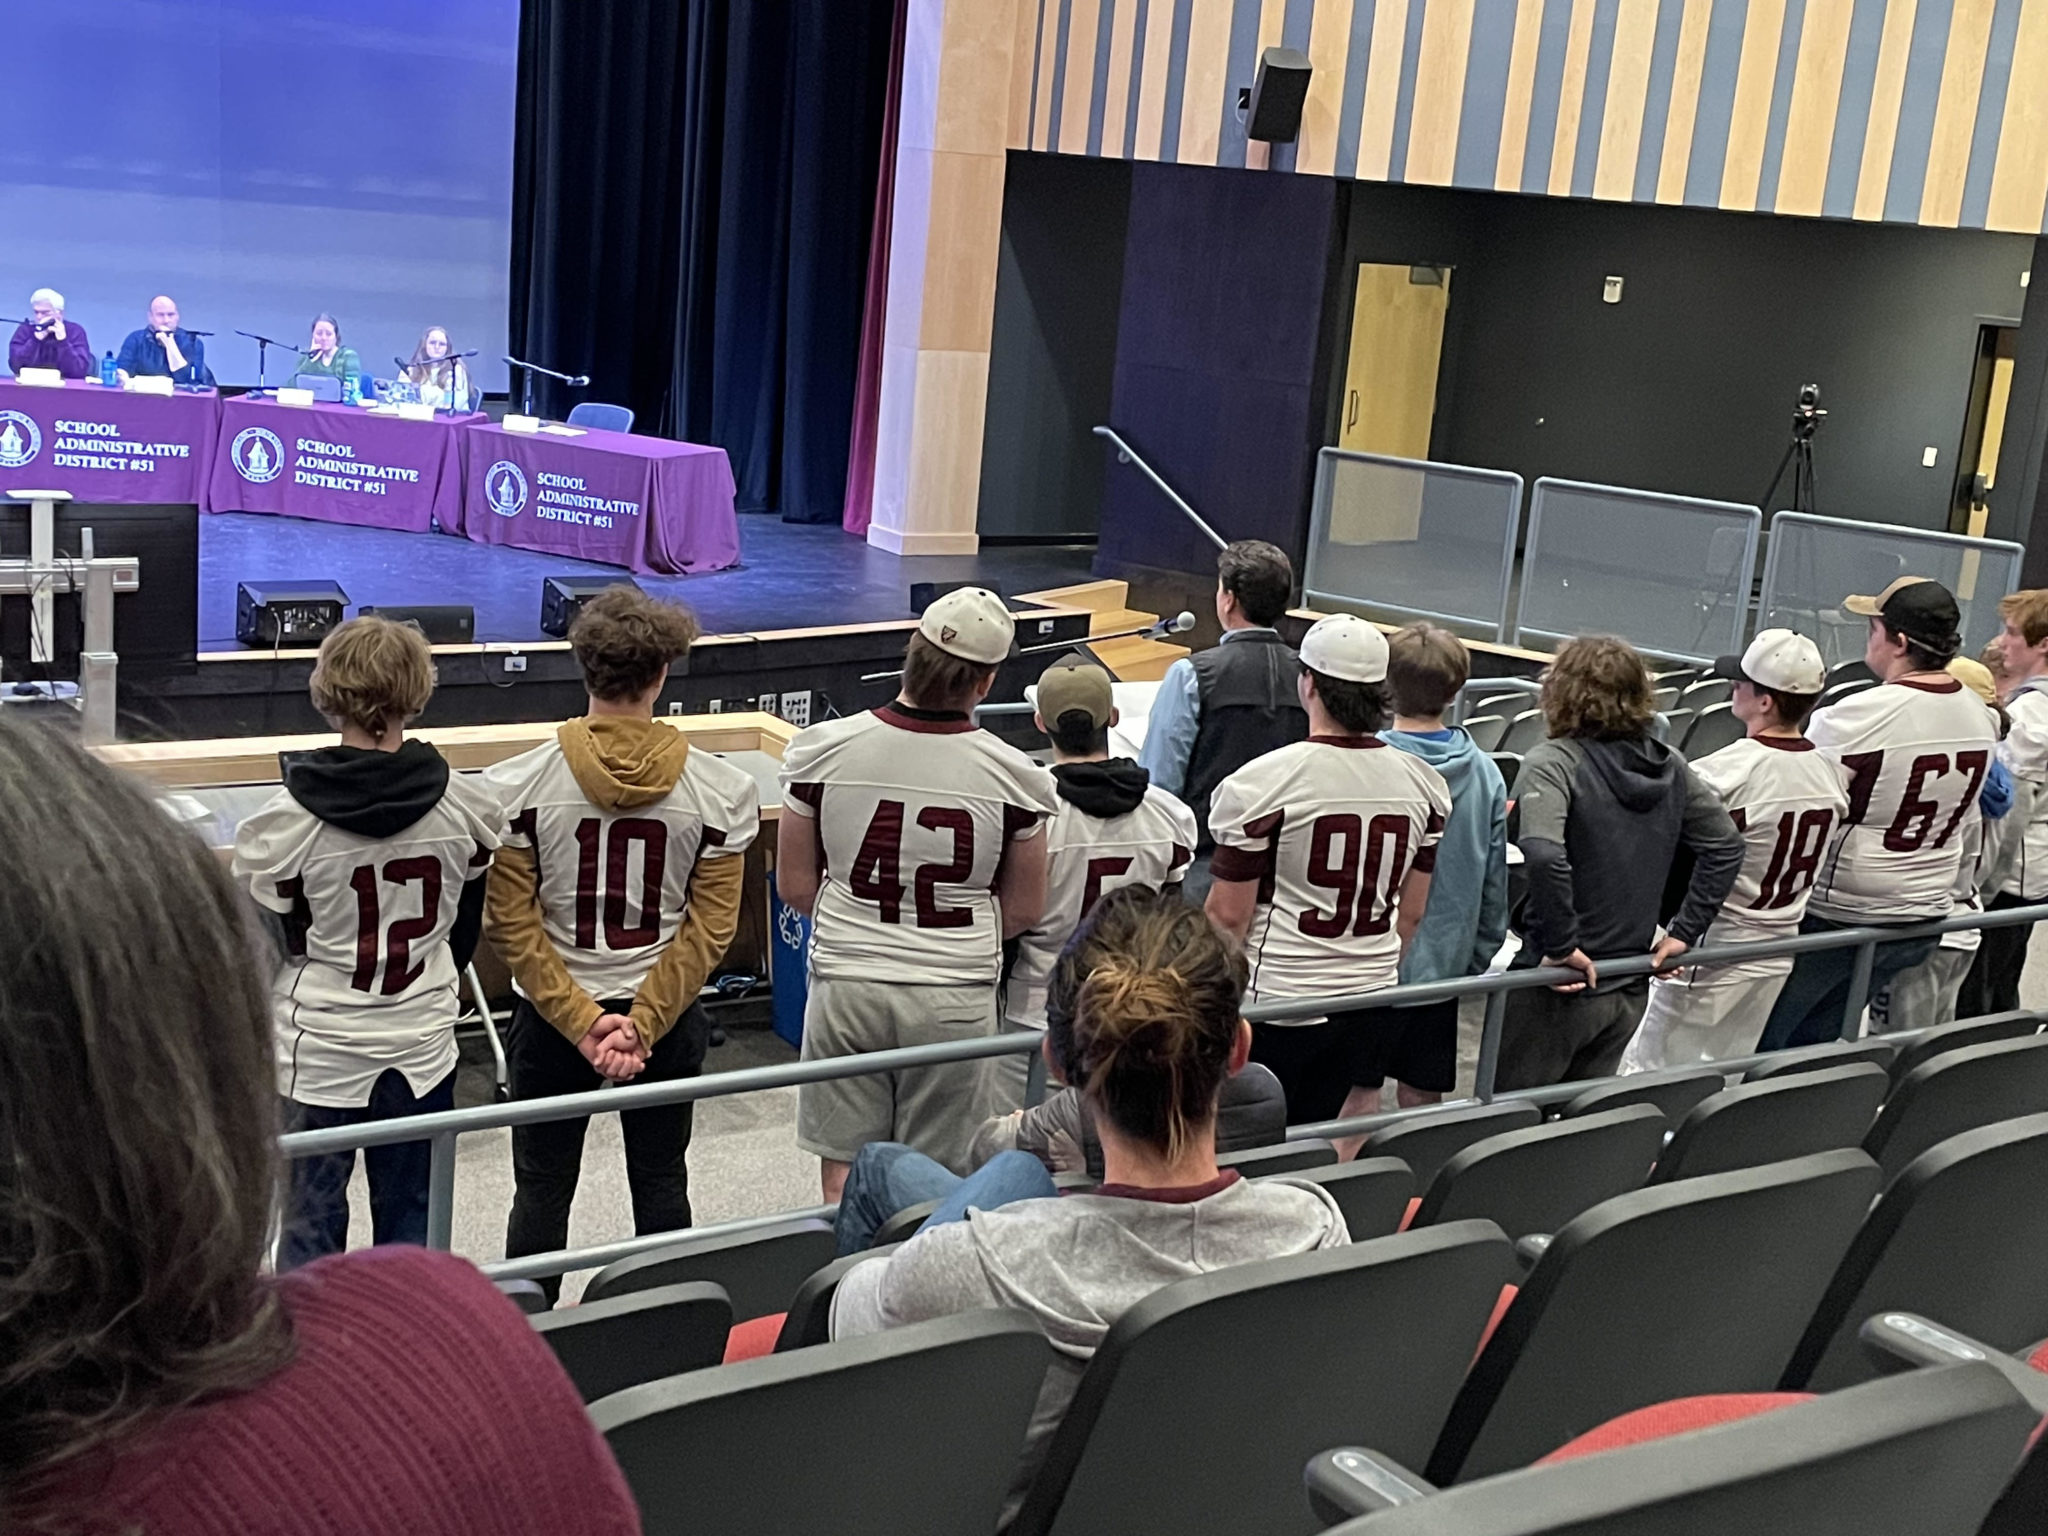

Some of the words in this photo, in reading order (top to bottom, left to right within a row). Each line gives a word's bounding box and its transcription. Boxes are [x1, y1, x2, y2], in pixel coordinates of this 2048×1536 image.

[54, 420, 120, 437] SCHOOL
[54, 437, 189, 457] ADMINISTRATIVE
[296, 438, 355, 458] SCHOOL
[53, 453, 128, 471] DISTRICT
[130, 460, 155, 472] #51
[295, 456, 418, 482] ADMINISTRATIVE
[294, 471, 361, 492] DISTRICT
[364, 482, 387, 496] #51
[537, 472, 586, 490] SCHOOL
[537, 490, 639, 515] ADMINISTRATIVE
[537, 506, 592, 525] DISTRICT
[593, 516, 612, 528] #51
[1883, 750, 1988, 852] 67
[849, 800, 974, 928] 42
[1747, 808, 1834, 910] 18
[575, 818, 667, 950] 10
[1298, 813, 1410, 938] 90
[350, 855, 442, 996] 12
